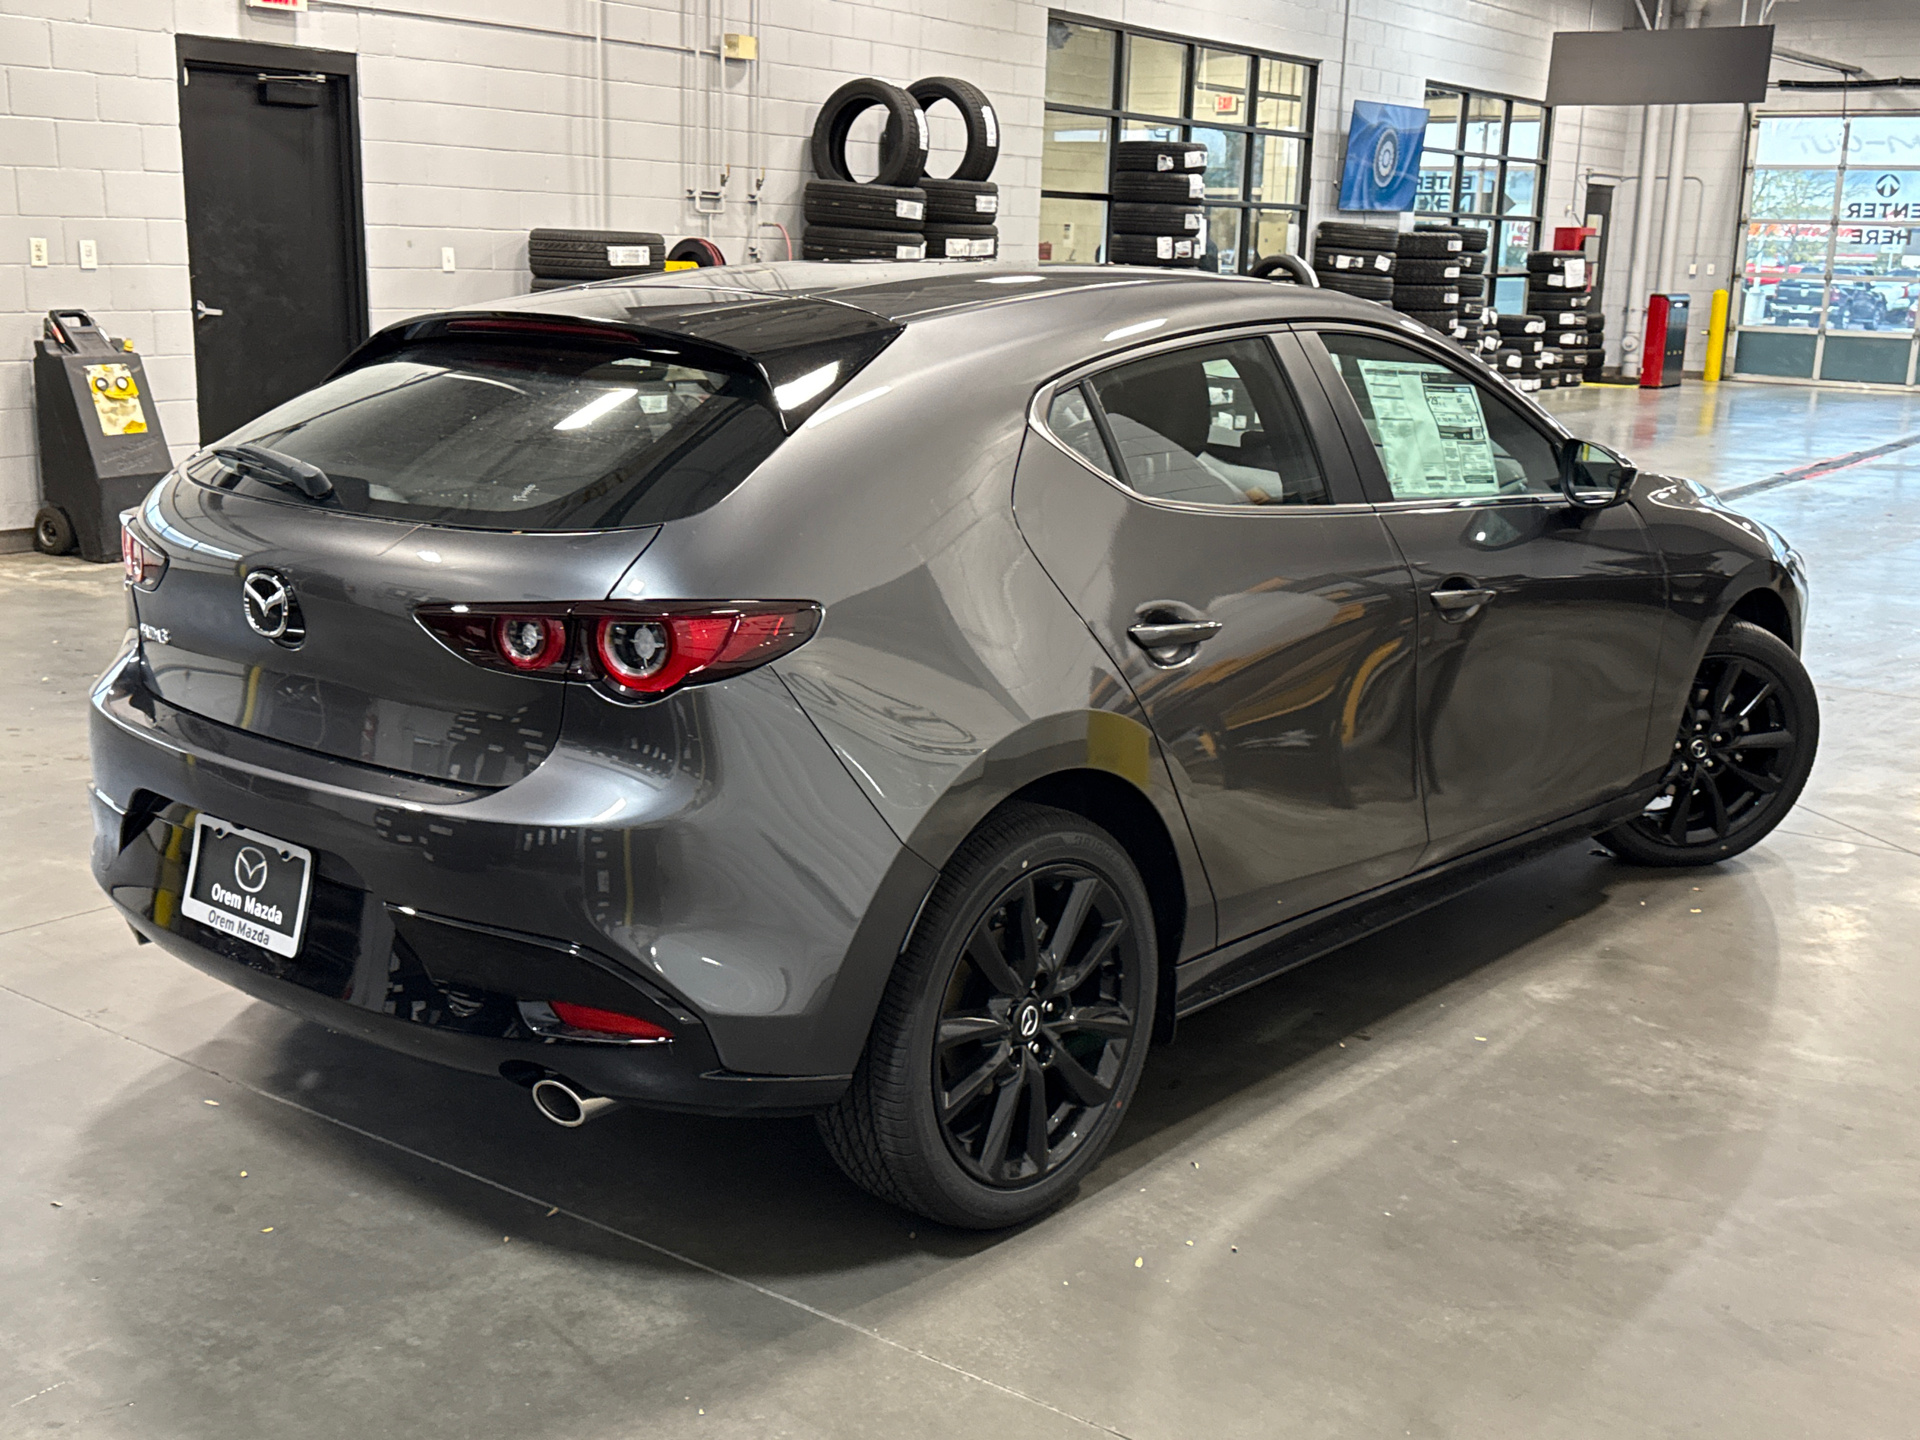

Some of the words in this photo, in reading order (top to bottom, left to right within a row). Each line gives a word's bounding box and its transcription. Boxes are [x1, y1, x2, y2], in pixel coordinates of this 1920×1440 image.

[211, 882, 242, 910] Orem
[244, 895, 283, 926] Mazda
[207, 909, 235, 932] Orem
[236, 920, 270, 946] Mazda
